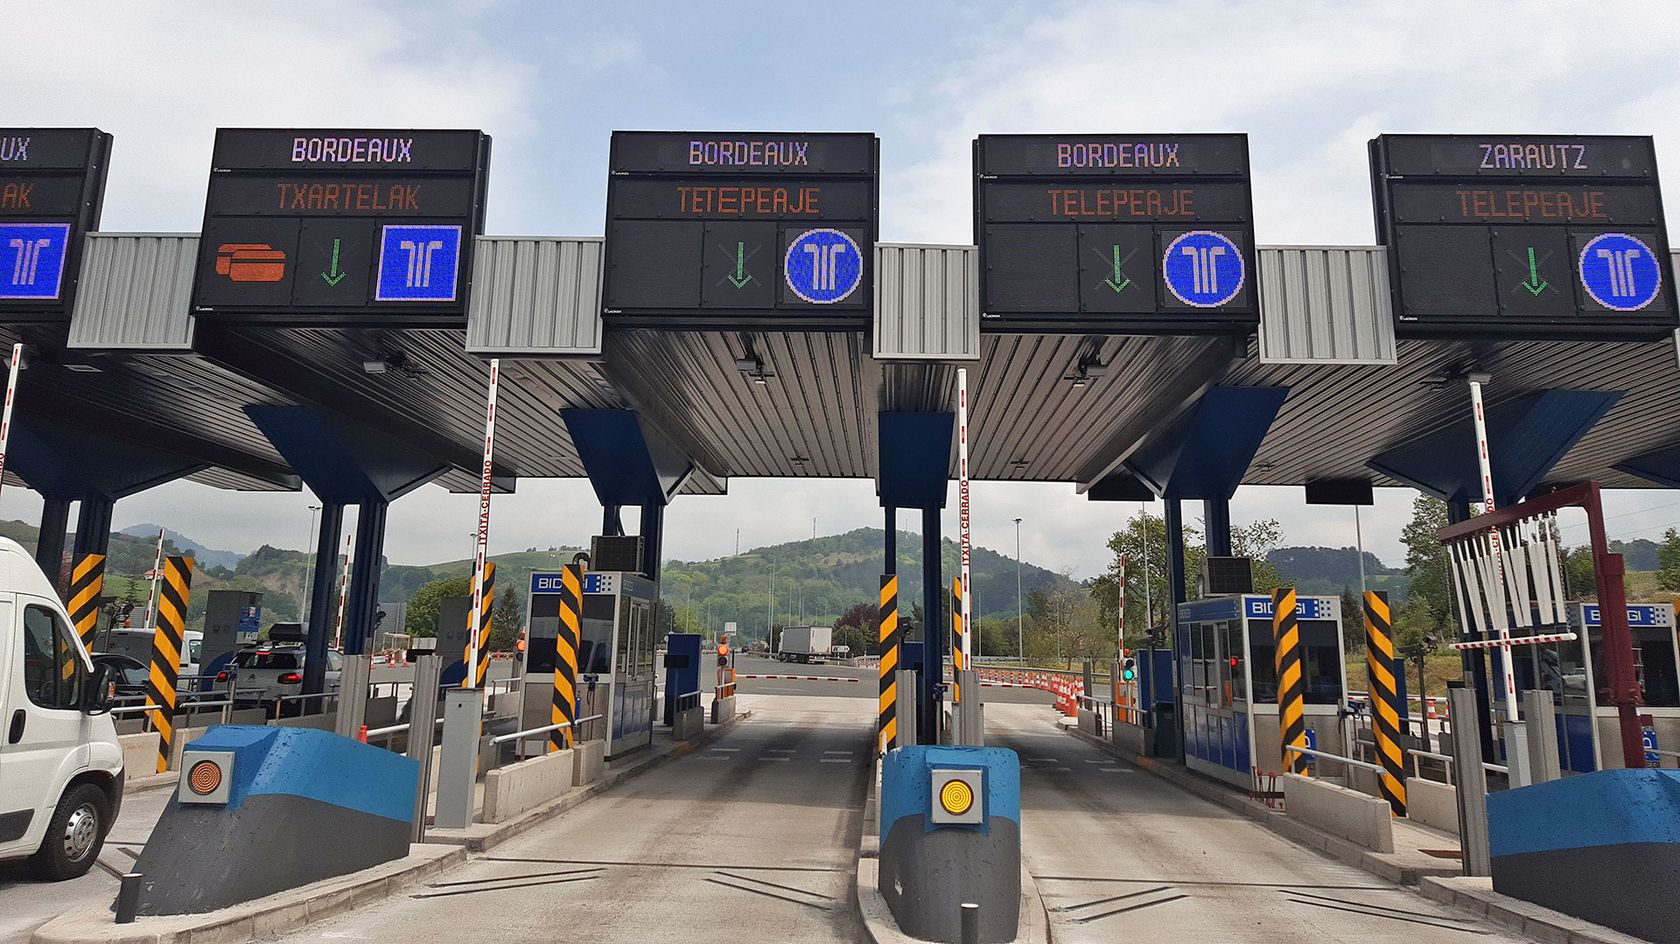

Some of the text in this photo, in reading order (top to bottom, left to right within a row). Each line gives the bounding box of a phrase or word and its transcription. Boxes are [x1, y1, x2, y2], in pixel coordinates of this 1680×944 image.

[291, 138, 413, 163] BORDEAUX
[689, 141, 809, 166] BORDEAUX
[1057, 143, 1180, 168] BORDEAUX
[1478, 144, 1588, 169] ZARAUTZ
[277, 184, 421, 210] TXARTELAK
[1048, 189, 1195, 216] TELEPEAJE
[1456, 190, 1607, 218] TELEPEAJE
